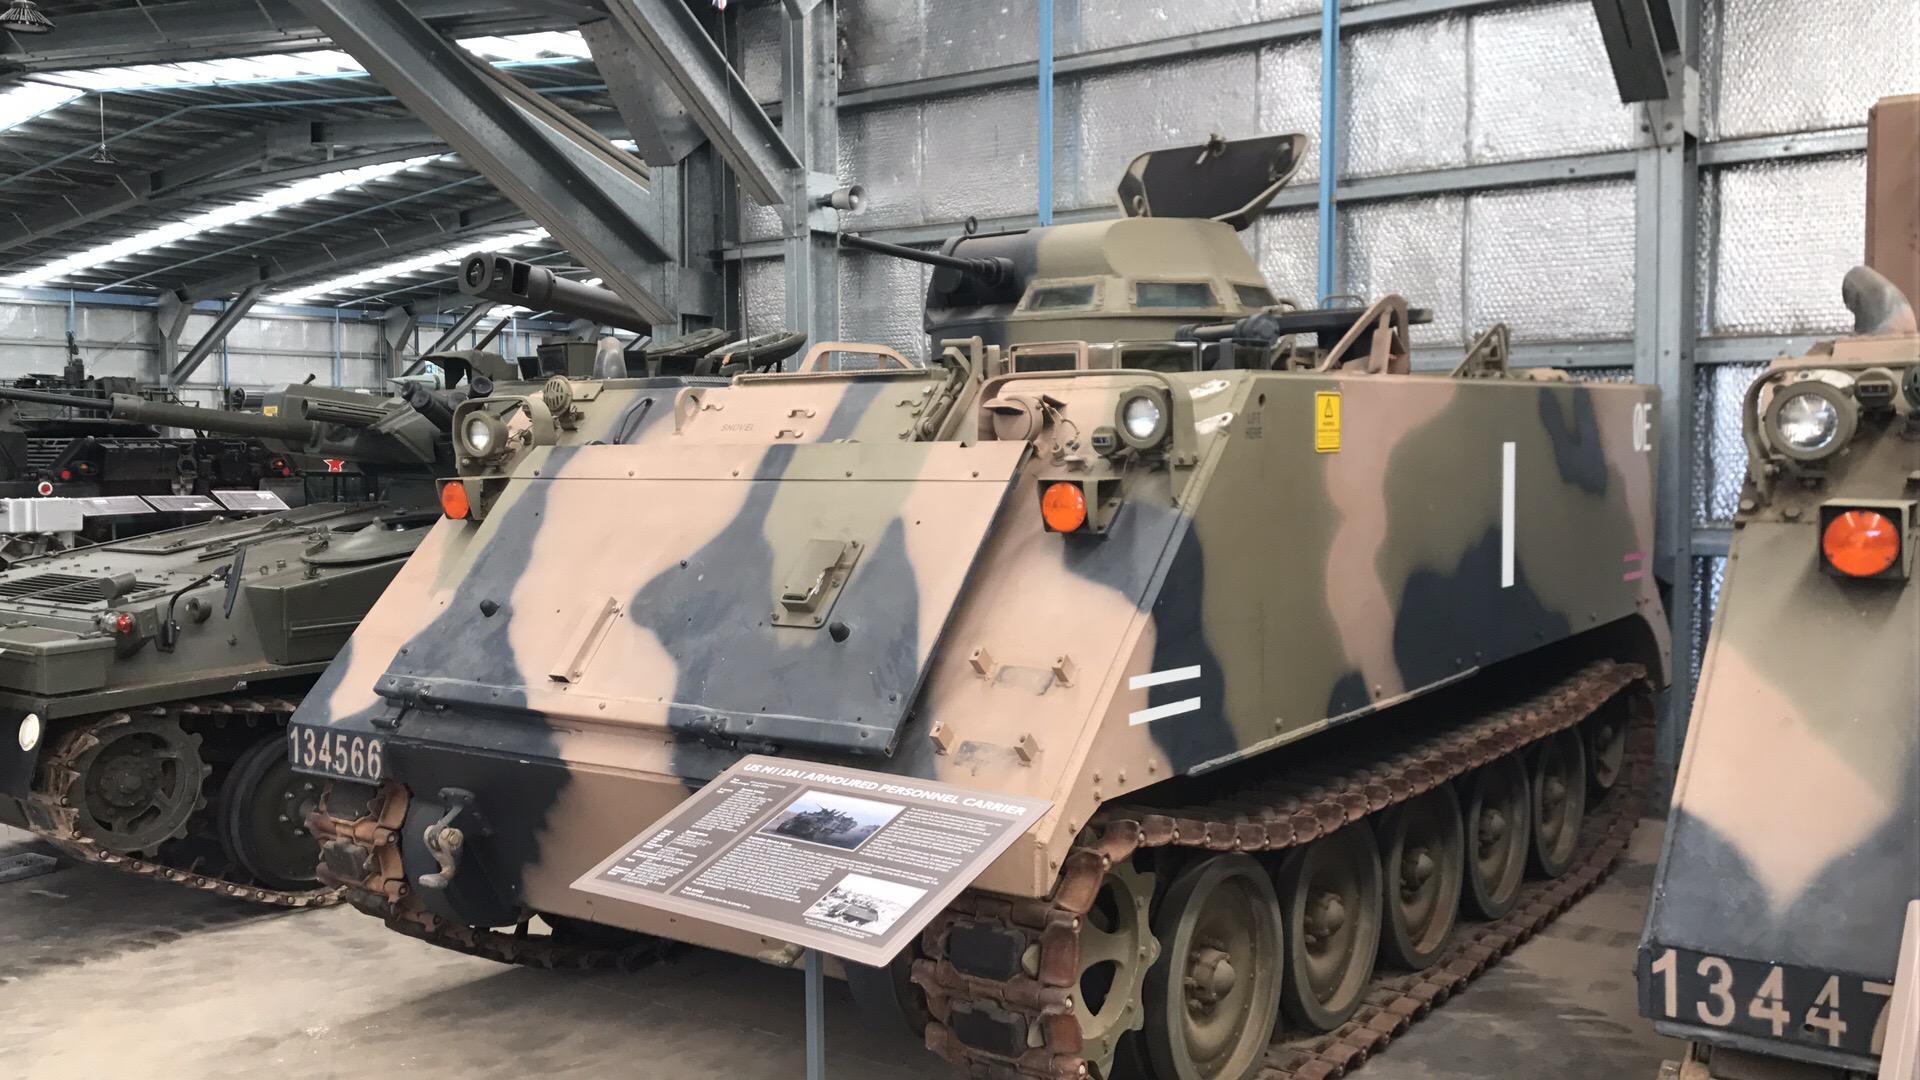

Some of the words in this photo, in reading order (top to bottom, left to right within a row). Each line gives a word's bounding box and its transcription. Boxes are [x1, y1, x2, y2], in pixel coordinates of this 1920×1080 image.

[290, 726, 382, 780] 134566
[743, 763, 760, 773] US
[761, 765, 804, 779] M113A1
[804, 772, 879, 791] ARMOURED
[878, 783, 959, 805] PERSONNEL
[962, 797, 1027, 816] CARRIER
[1652, 948, 1894, 1055] 13447
